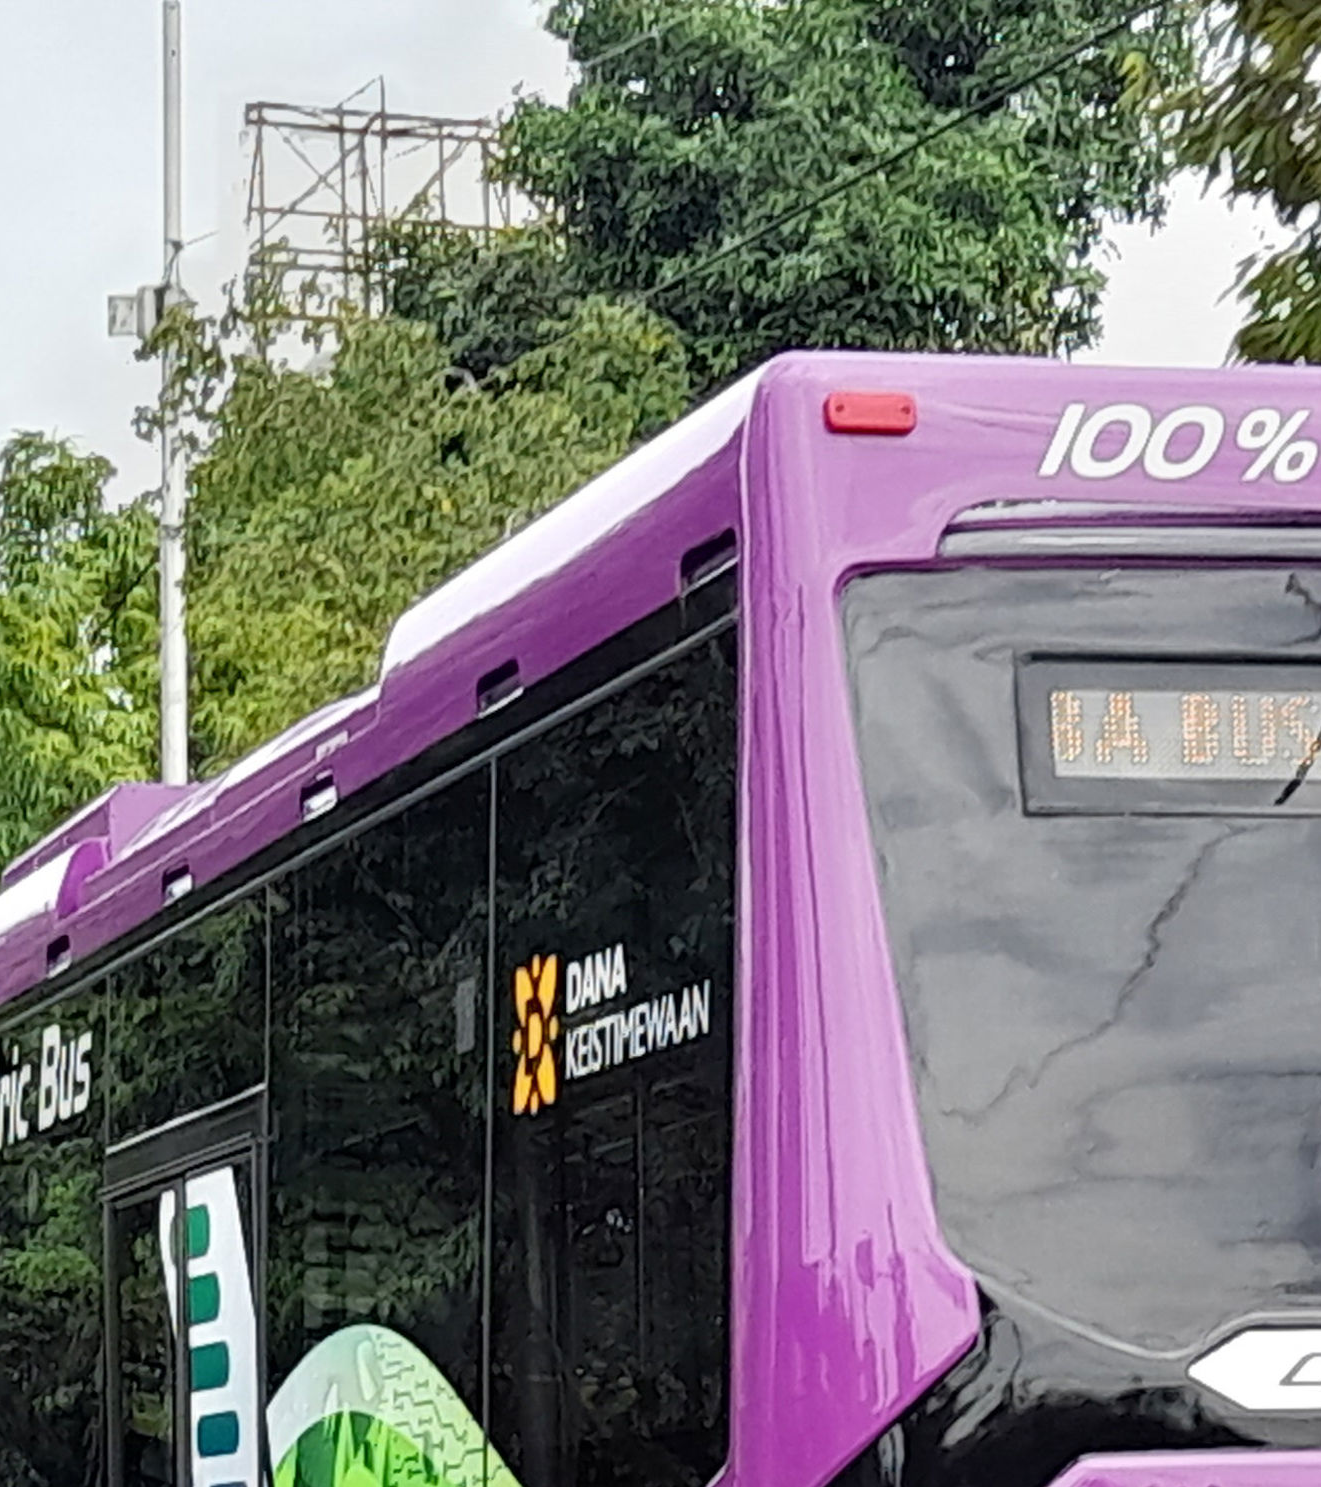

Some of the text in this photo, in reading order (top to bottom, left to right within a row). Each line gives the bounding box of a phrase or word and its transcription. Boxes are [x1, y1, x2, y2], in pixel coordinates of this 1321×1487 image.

[1037, 402, 1321, 484] 100%
[1181, 692, 1321, 767] BUS
[565, 942, 627, 1015] DANA
[564, 978, 711, 1080] KEISTIMEWAAN
[38, 1023, 93, 1132] Bus
